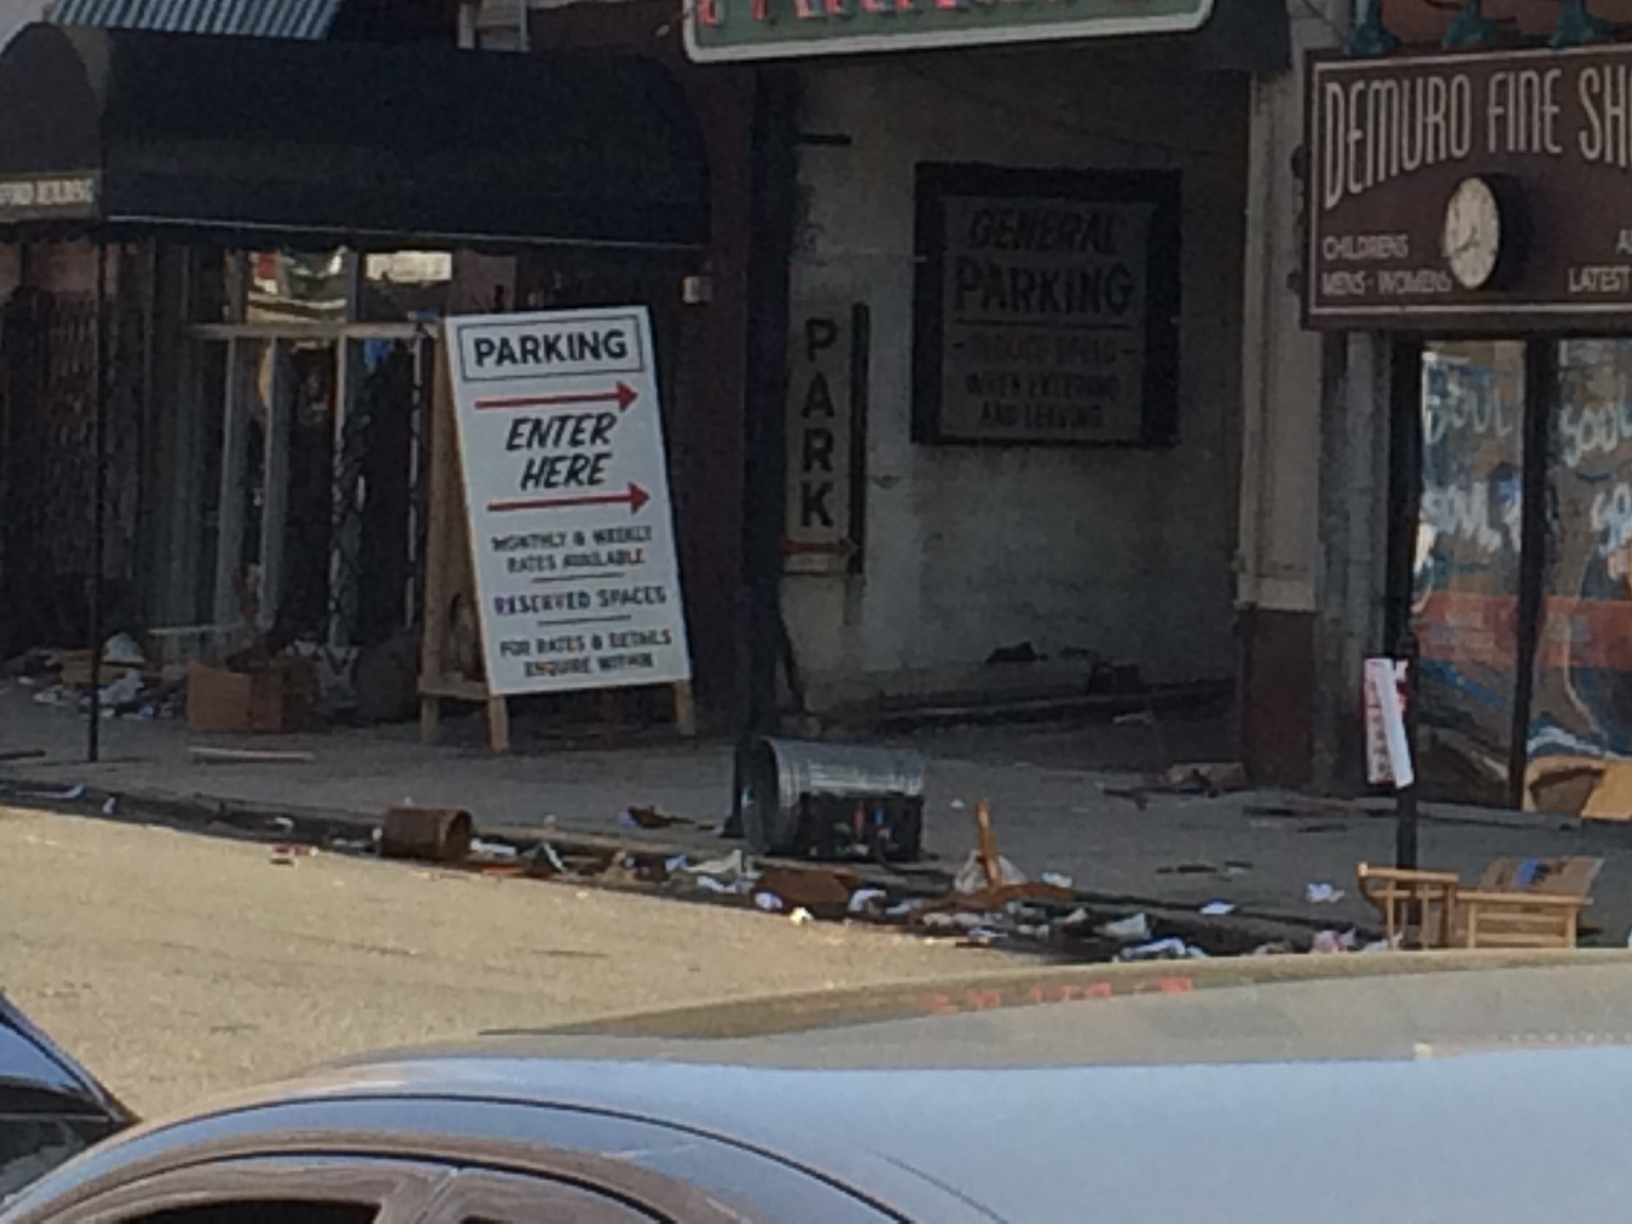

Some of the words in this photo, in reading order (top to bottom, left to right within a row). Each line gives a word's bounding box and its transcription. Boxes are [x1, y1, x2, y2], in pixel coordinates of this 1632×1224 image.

[1324, 73, 1473, 211] DEMURO
[1487, 68, 1563, 154] FINE
[968, 207, 1118, 255] GENERAL
[953, 256, 1136, 317] PARKING
[1568, 266, 1632, 293] LATEST
[473, 329, 628, 368] PARKING
[505, 412, 618, 453] ENTER
[801, 317, 839, 527] PARK
[520, 452, 613, 492] HERE
[493, 591, 591, 615] RESERVED
[596, 585, 667, 608] SPACES
[499, 640, 531, 657] FOR
